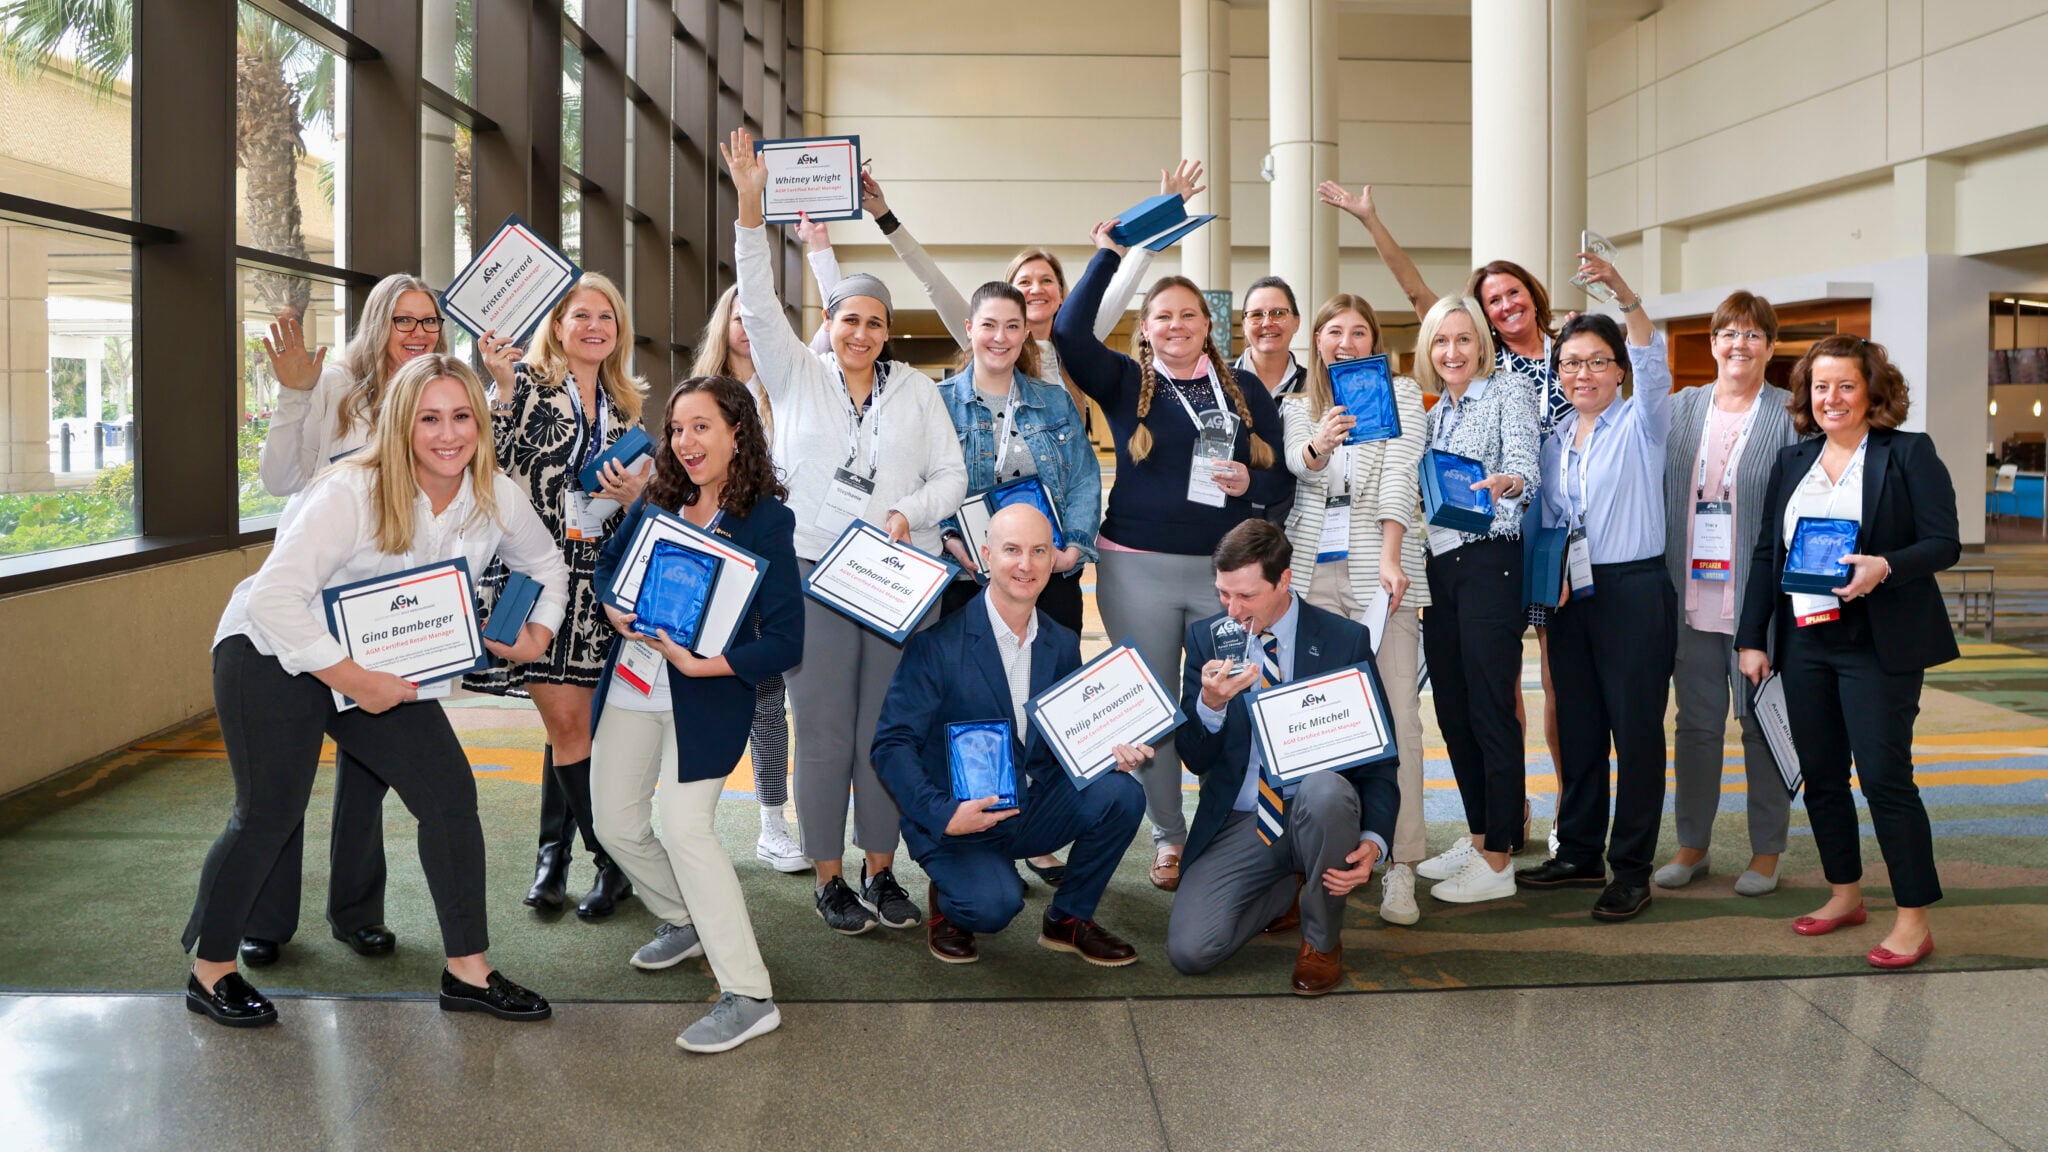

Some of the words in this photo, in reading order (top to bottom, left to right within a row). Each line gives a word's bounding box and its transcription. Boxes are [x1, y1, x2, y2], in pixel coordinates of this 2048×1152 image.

[797, 154, 818, 165] AGM
[776, 175, 810, 185] Whitney
[812, 174, 841, 183] Wright
[482, 262, 502, 284] AGM
[481, 287, 507, 316] Kristen
[506, 255, 533, 287] Everard
[881, 556, 906, 570] AGM
[846, 559, 890, 586] Stephanie
[890, 582, 914, 596] Grisi
[390, 595, 418, 612] AGM
[362, 630, 388, 644] Gina
[392, 614, 454, 636] Bamberger
[1216, 620, 1246, 636] AGM
[366, 645, 381, 656] AGM
[382, 638, 408, 652] Certified
[410, 634, 427, 644] Retail
[428, 629, 454, 640] Manager
[1082, 682, 1105, 702] AGM
[1302, 694, 1326, 708] AGM
[1065, 719, 1091, 740] Philip
[1092, 683, 1144, 722] Arrowsmith
[1288, 722, 1307, 734] Eric
[1309, 708, 1350, 728] Mitchell
[1772, 703, 1784, 724] Anna
[1283, 738, 1296, 746] AGM
[1297, 730, 1320, 742] Certified
[1321, 726, 1337, 736] Retail
[1338, 720, 1362, 732] Manager
